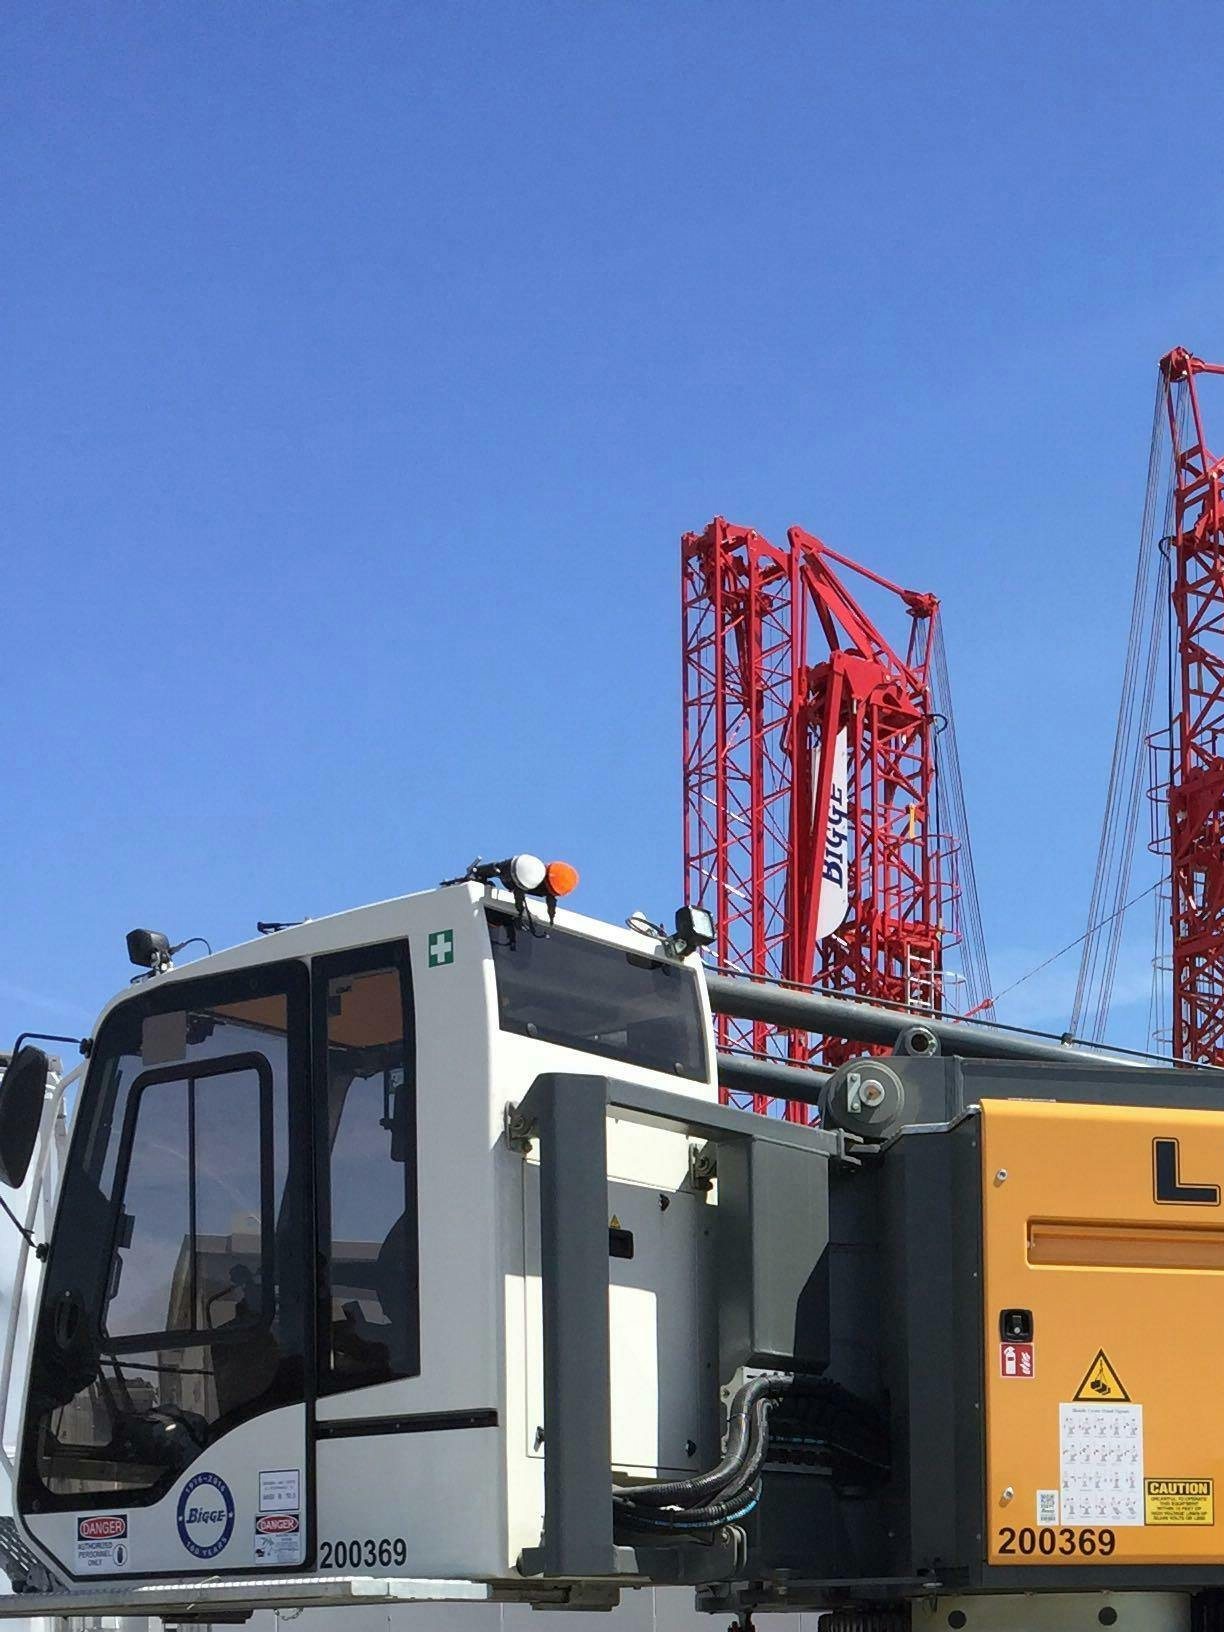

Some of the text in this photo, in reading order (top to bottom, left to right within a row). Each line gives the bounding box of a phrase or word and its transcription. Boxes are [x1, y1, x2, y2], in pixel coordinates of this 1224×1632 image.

[1150, 1482, 1208, 1495] CAUTION
[82, 1520, 122, 1535] DANGER
[259, 1519, 295, 1531] DANGER
[998, 1527, 1116, 1556] 200369
[320, 1537, 407, 1569] 200369
